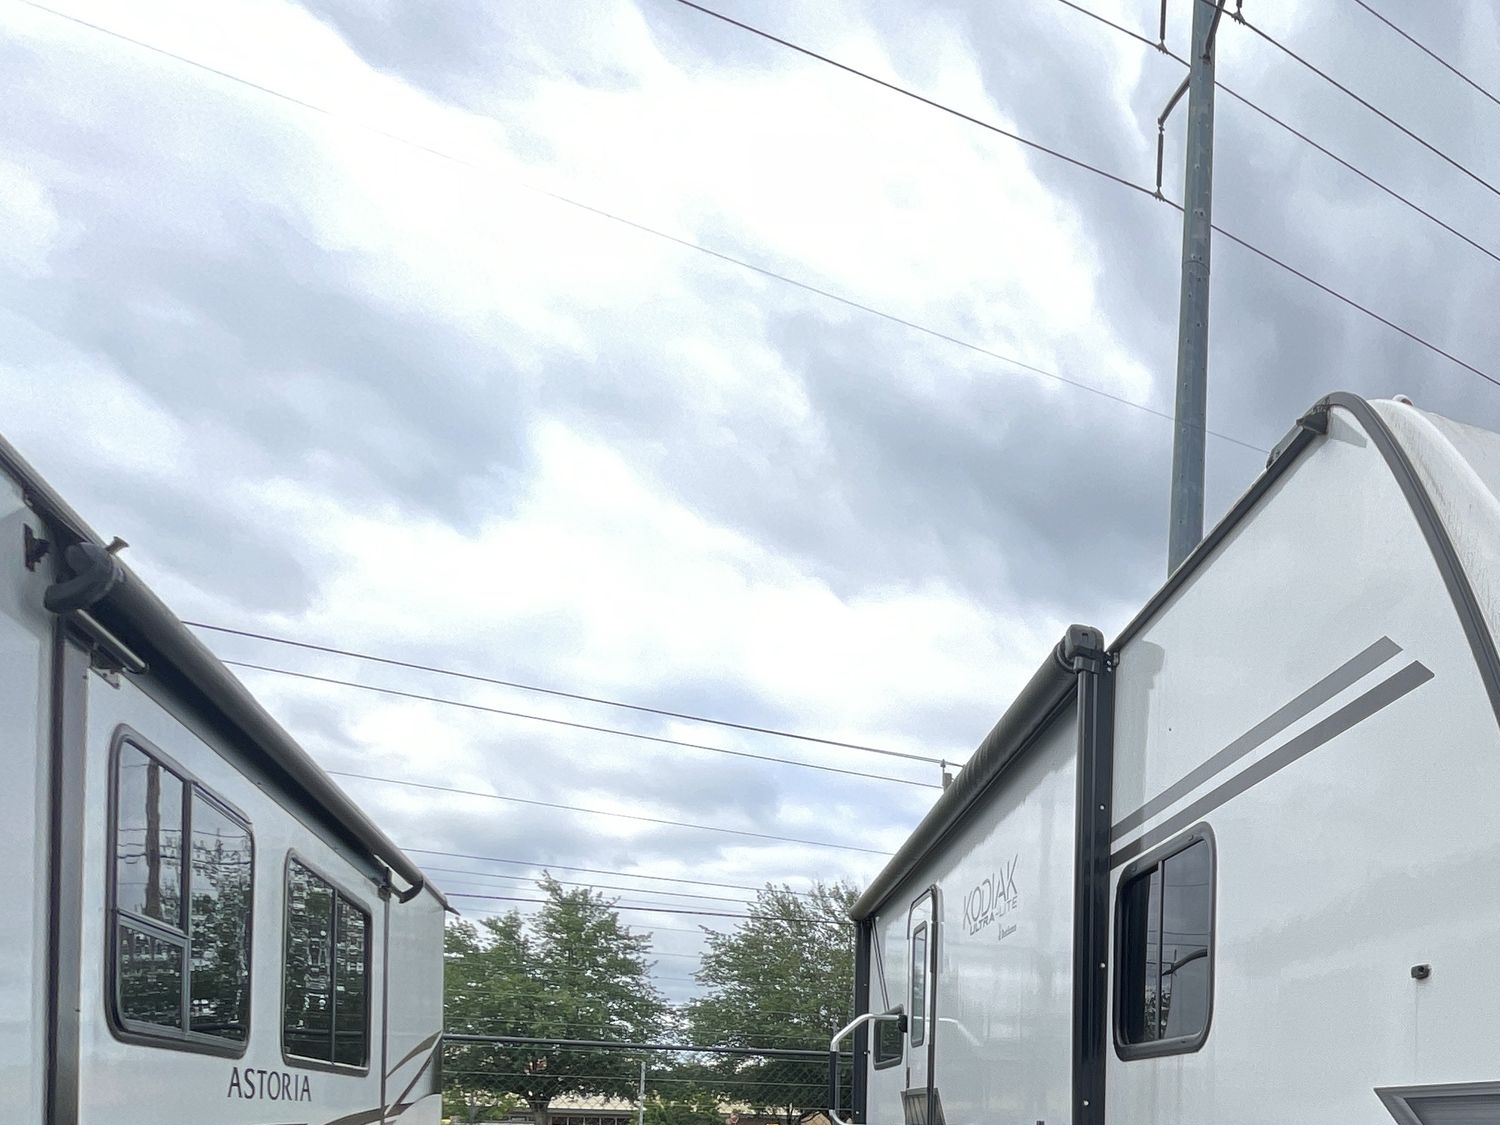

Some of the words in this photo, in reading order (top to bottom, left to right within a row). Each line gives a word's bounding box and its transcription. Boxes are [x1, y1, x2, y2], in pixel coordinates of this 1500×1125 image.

[962, 854, 1018, 930] KODIAK
[969, 895, 1018, 936] ULTRA-LITE
[227, 1066, 312, 1102] ASTORIA
